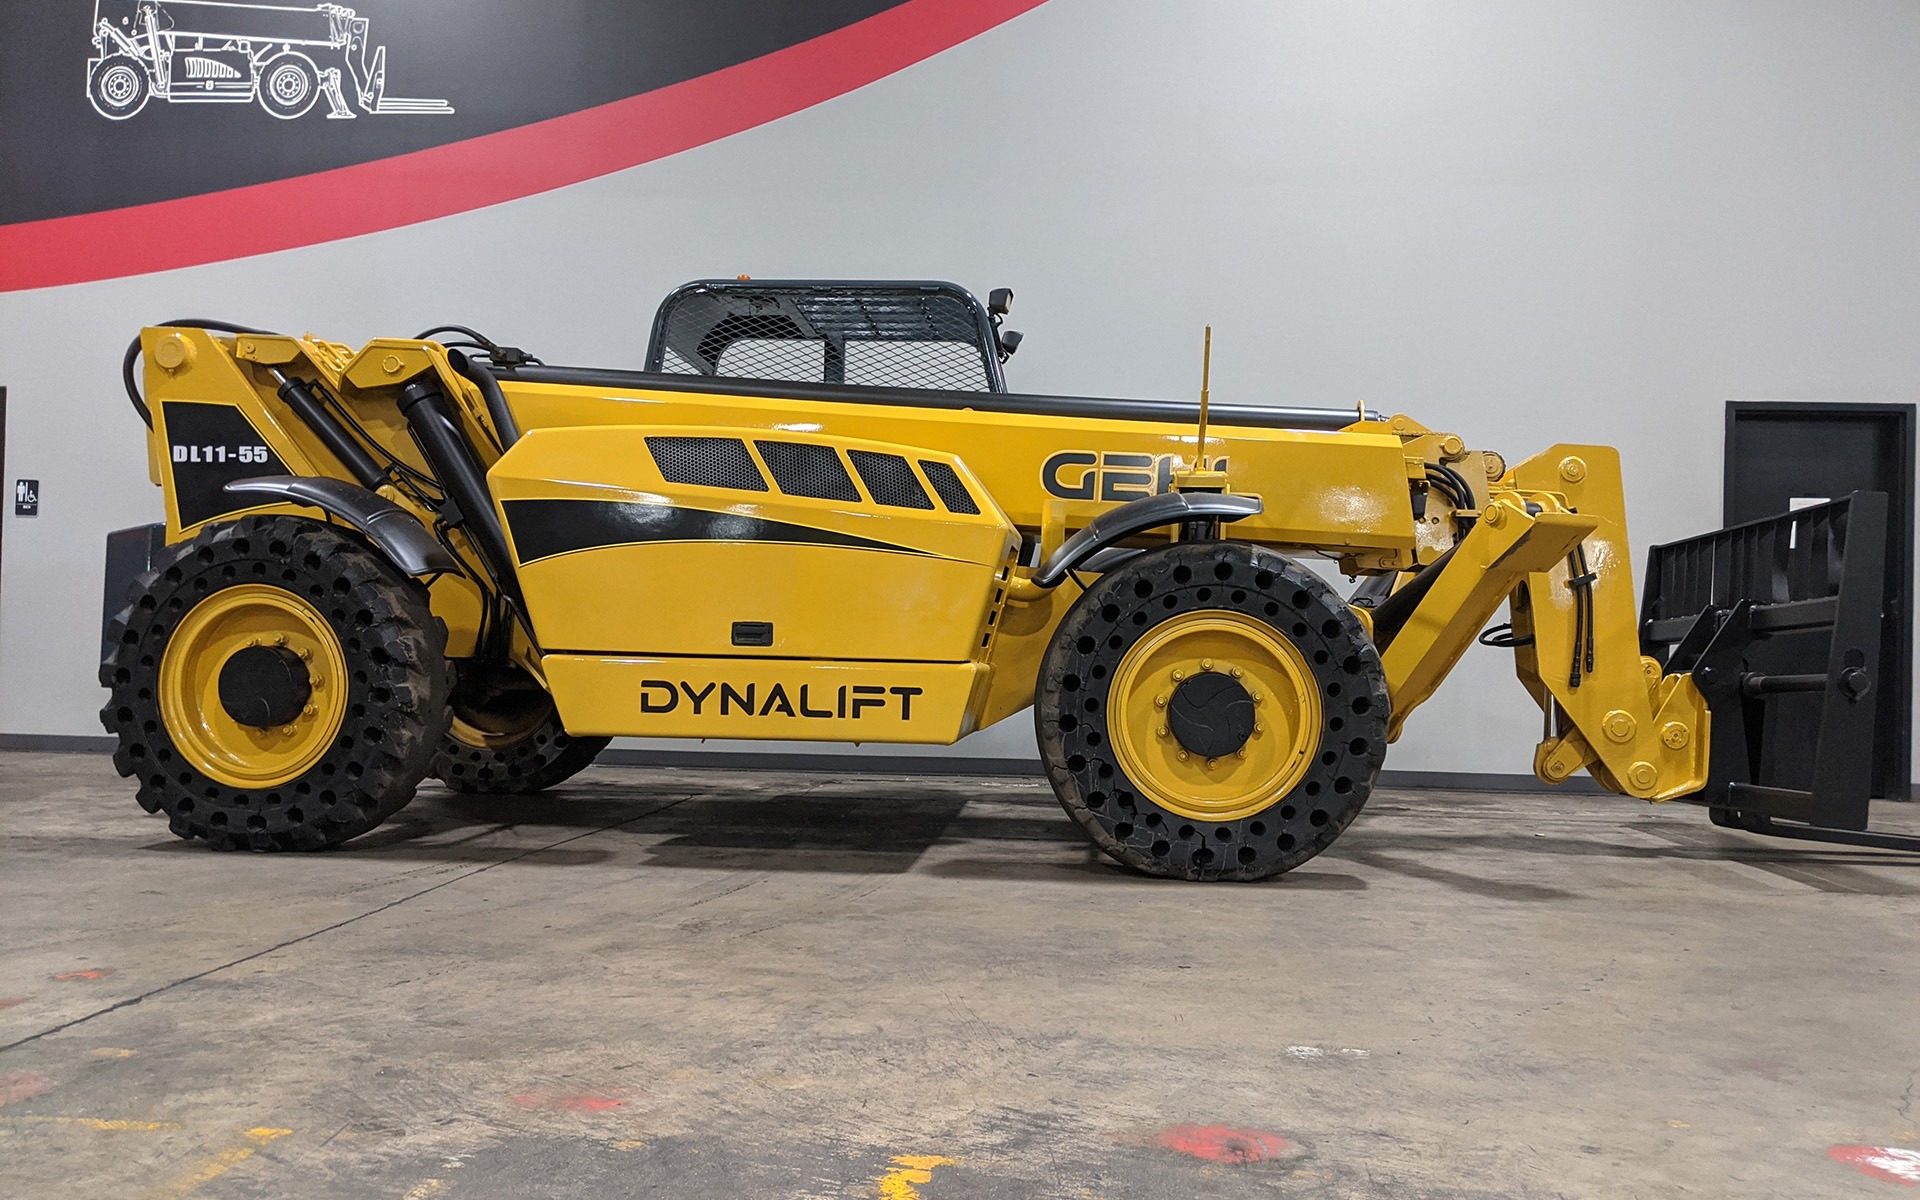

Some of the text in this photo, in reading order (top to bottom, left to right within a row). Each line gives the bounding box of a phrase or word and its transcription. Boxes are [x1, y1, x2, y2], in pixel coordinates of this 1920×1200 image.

[173, 445, 268, 463] DL11-55
[1041, 450, 1262, 503] GEH
[640, 679, 923, 721] DYNALIFT
